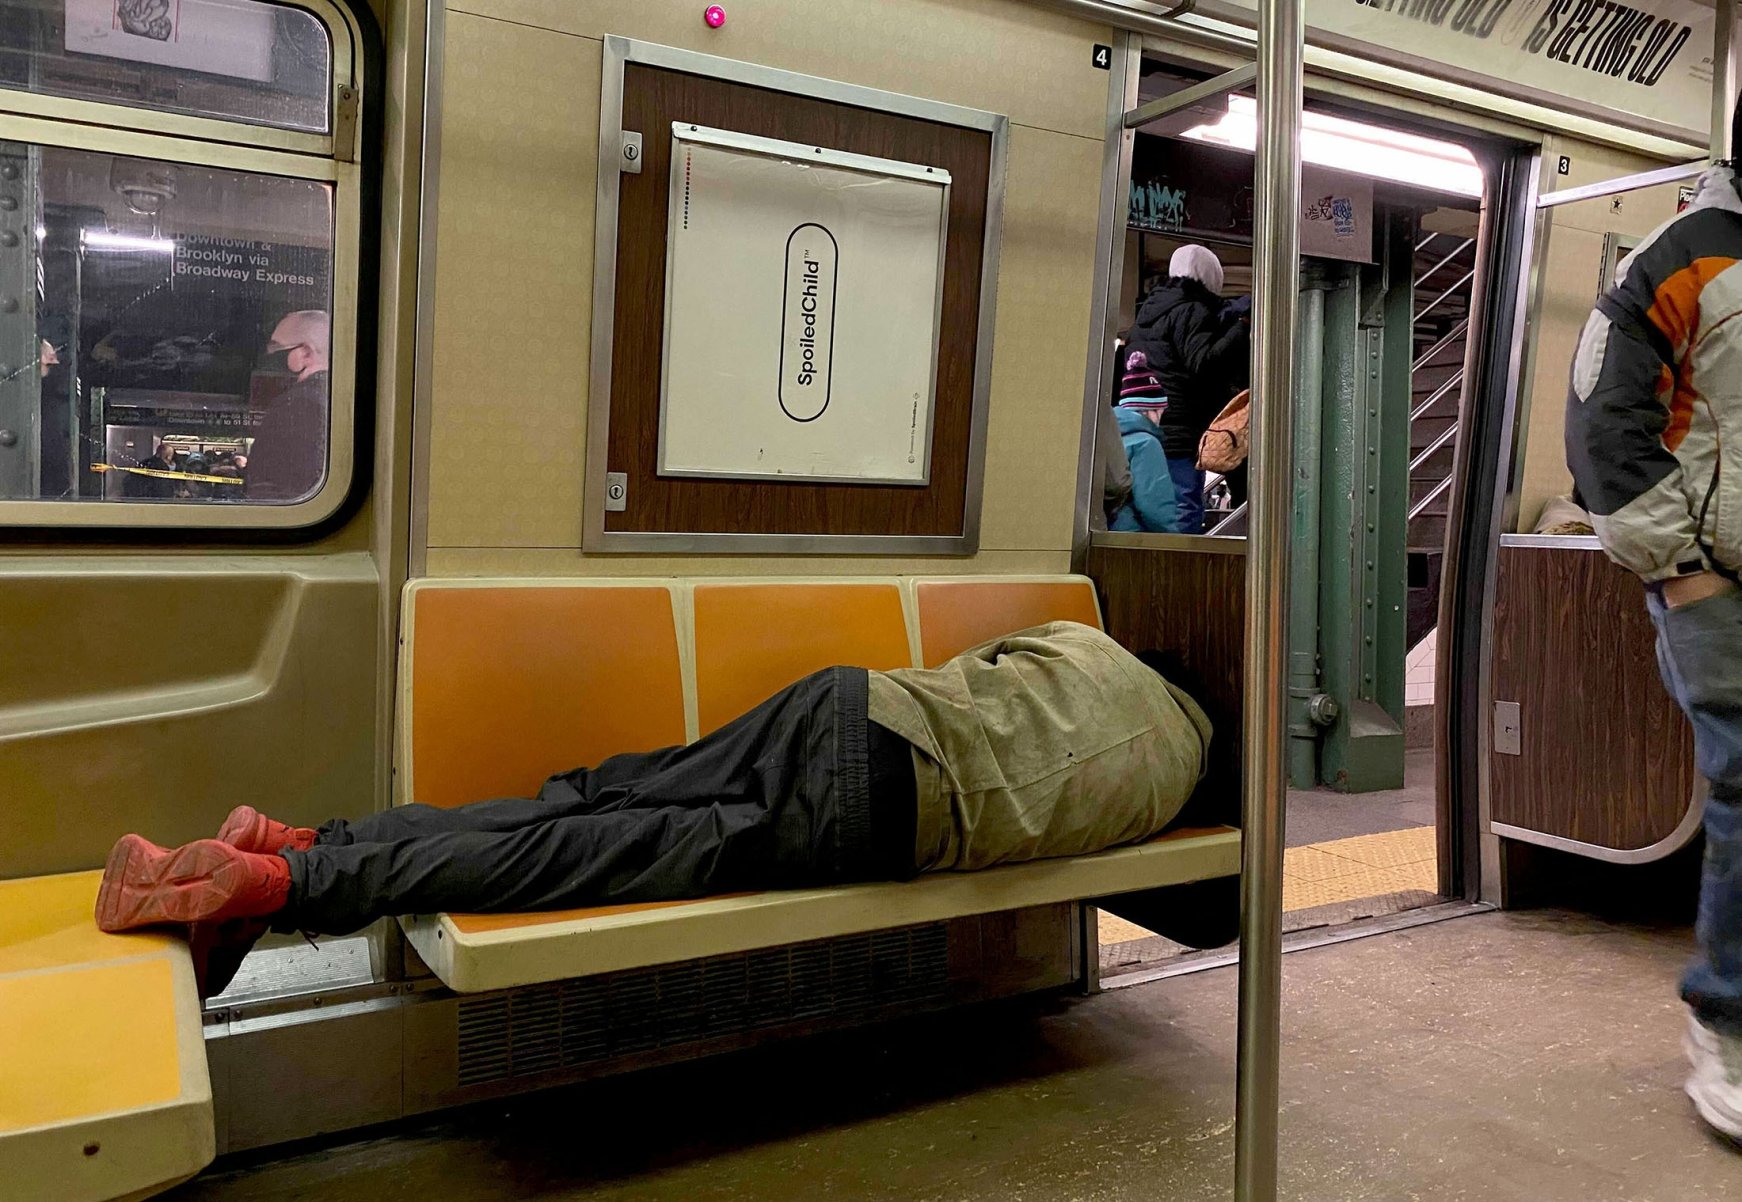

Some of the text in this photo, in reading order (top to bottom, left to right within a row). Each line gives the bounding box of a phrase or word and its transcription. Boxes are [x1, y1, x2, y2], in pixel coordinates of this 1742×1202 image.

[1546, 0, 1656, 78] GETTING
[1627, 15, 1692, 87] OLD
[1096, 49, 1107, 66] 4
[1560, 158, 1568, 172] 3
[175, 233, 255, 250] Downtown
[175, 245, 270, 267] Brooklyn via
[175, 261, 315, 286] Broadway Express
[797, 260, 819, 386] SpoiledChild
